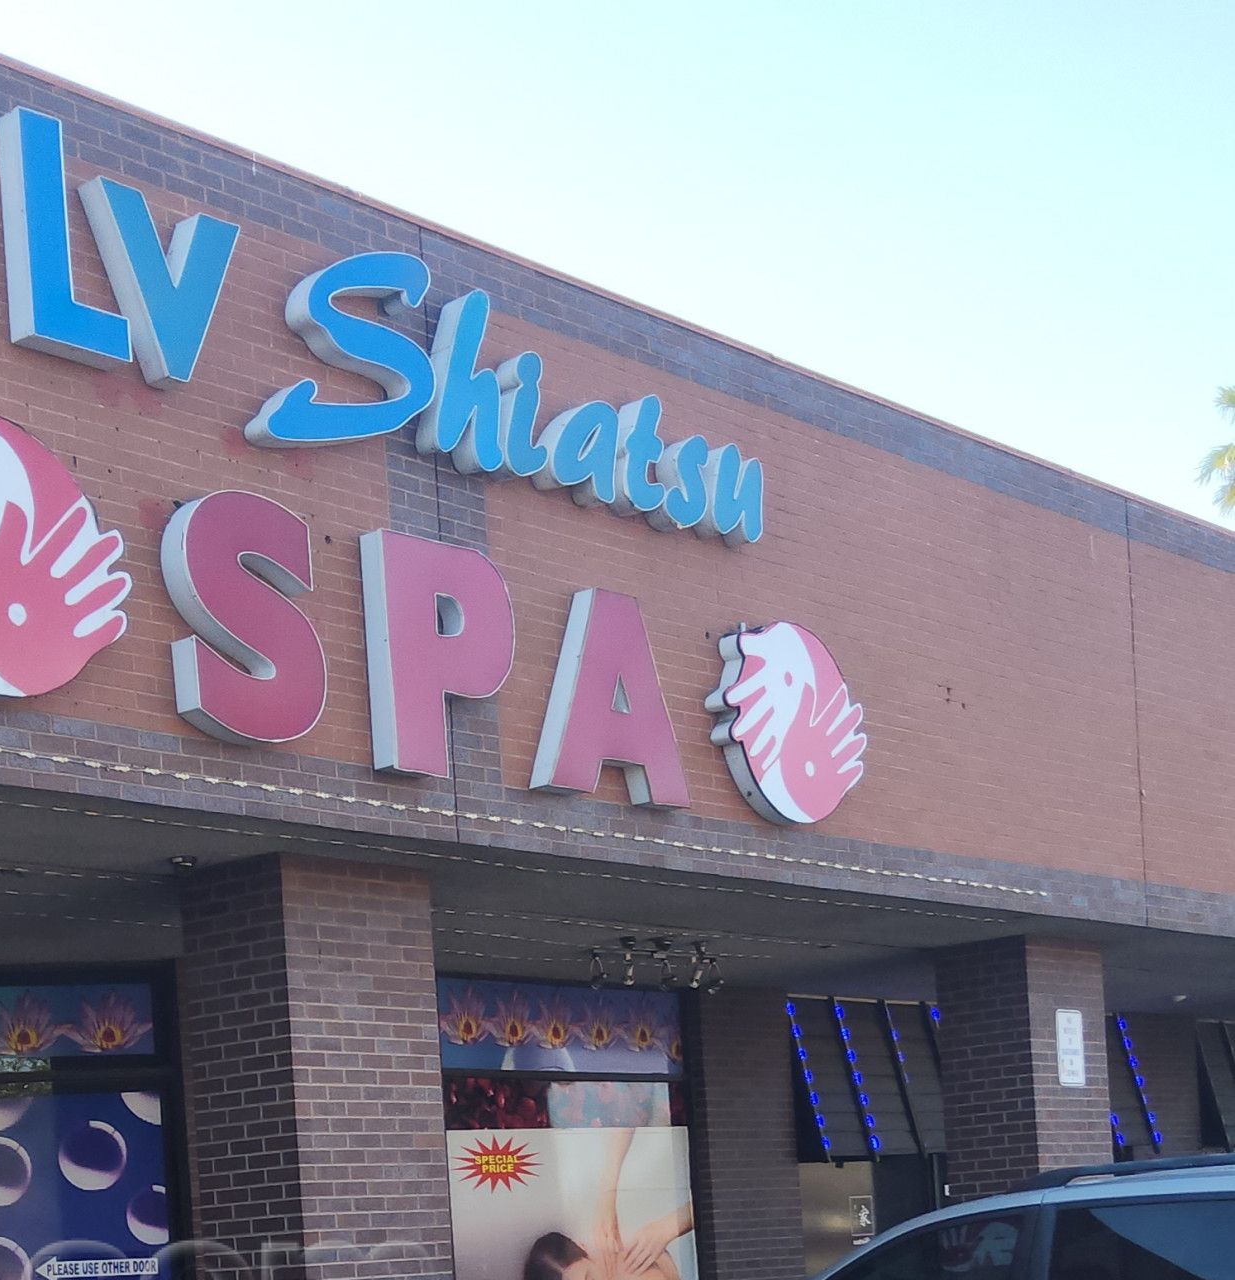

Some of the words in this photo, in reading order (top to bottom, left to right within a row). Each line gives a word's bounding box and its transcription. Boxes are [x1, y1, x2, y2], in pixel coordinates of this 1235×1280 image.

[243, 250, 764, 546] Shiatsu
[160, 489, 690, 809] SPA
[475, 1155, 519, 1164] SPECIAL
[481, 1164, 514, 1173] PRICE
[46, 1263, 80, 1276] PLEASE
[82, 1262, 99, 1274] USE
[101, 1261, 130, 1273] OTHER
[132, 1260, 157, 1273] DOOR
